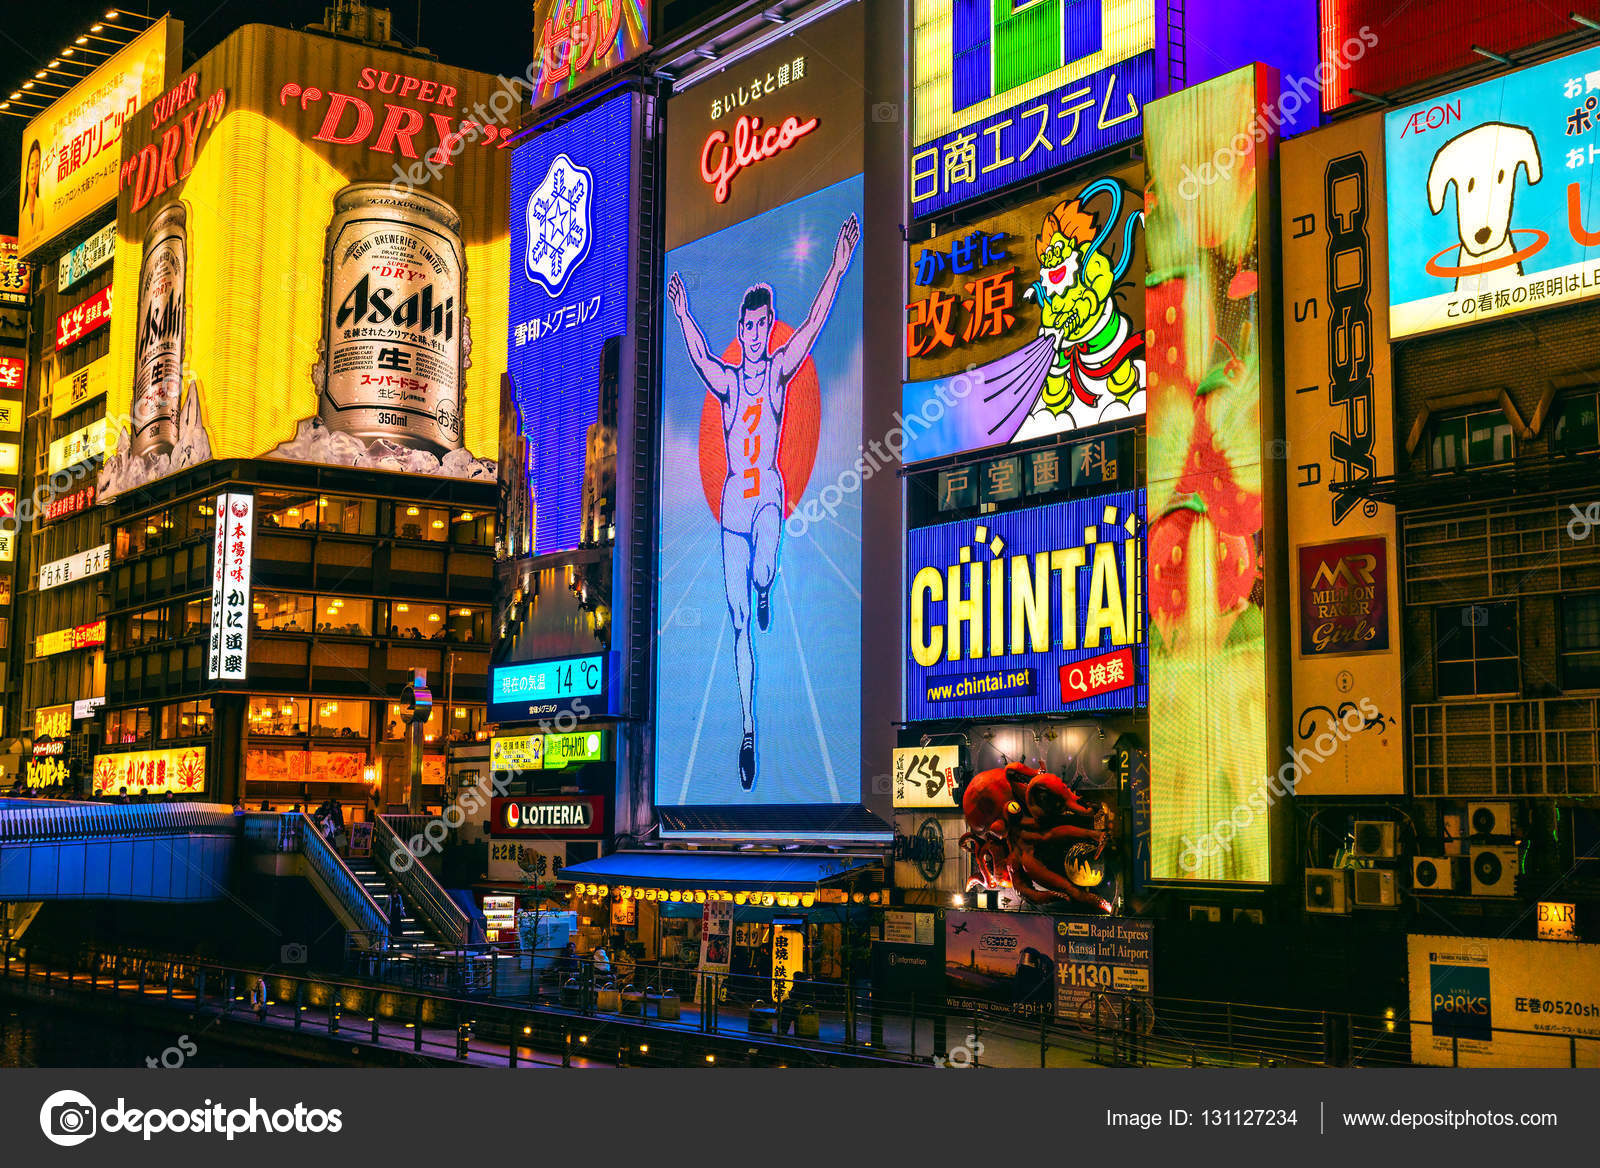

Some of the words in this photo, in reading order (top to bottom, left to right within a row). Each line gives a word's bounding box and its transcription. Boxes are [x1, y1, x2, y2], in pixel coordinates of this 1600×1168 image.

[151, 72, 198, 131] SUPER
[357, 67, 458, 107] SUPER
[710, 56, 806, 120] おいしさと健康
[1565, 97, 1600, 136] ポ
[911, 74, 1139, 203] 日商エステム
[701, 115, 819, 204] Glico
[352, 240, 372, 261] ASAHI
[374, 234, 418, 250] BREWERIES
[419, 246, 442, 275] LIMITED
[386, 260, 409, 268] SUPER
[914, 231, 1006, 286] かぜに
[335, 273, 454, 343] Asahi
[513, 295, 601, 347] 雪印メグミルク
[905, 266, 1017, 358] 改源
[1324, 150, 1377, 526] COSPA
[378, 347, 412, 373] 生
[360, 374, 429, 394] スーパードライ
[377, 388, 408, 401] 生ビール
[378, 411, 408, 428] 350ml
[742, 397, 764, 499] グリコ
[945, 440, 1106, 503] 戸堂歯科
[230, 522, 246, 583] 本場の味
[911, 506, 1142, 667] CHINTAI
[224, 589, 245, 673] かに道楽
[1311, 619, 1376, 651] Girls
[502, 673, 546, 694] 現在の気温
[555, 663, 574, 695] 14
[1088, 657, 1125, 689] 検索
[126, 759, 166, 787] かに道楽
[904, 754, 946, 799] くくる
[521, 804, 585, 826] LOTTERIA
[1090, 923, 1115, 942] Rapid
[1117, 925, 1149, 943] Express
[1538, 904, 1574, 922] BAR
[1057, 943, 1067, 953] to
[1068, 940, 1096, 955] Kansai
[1118, 944, 1149, 963] Airport
